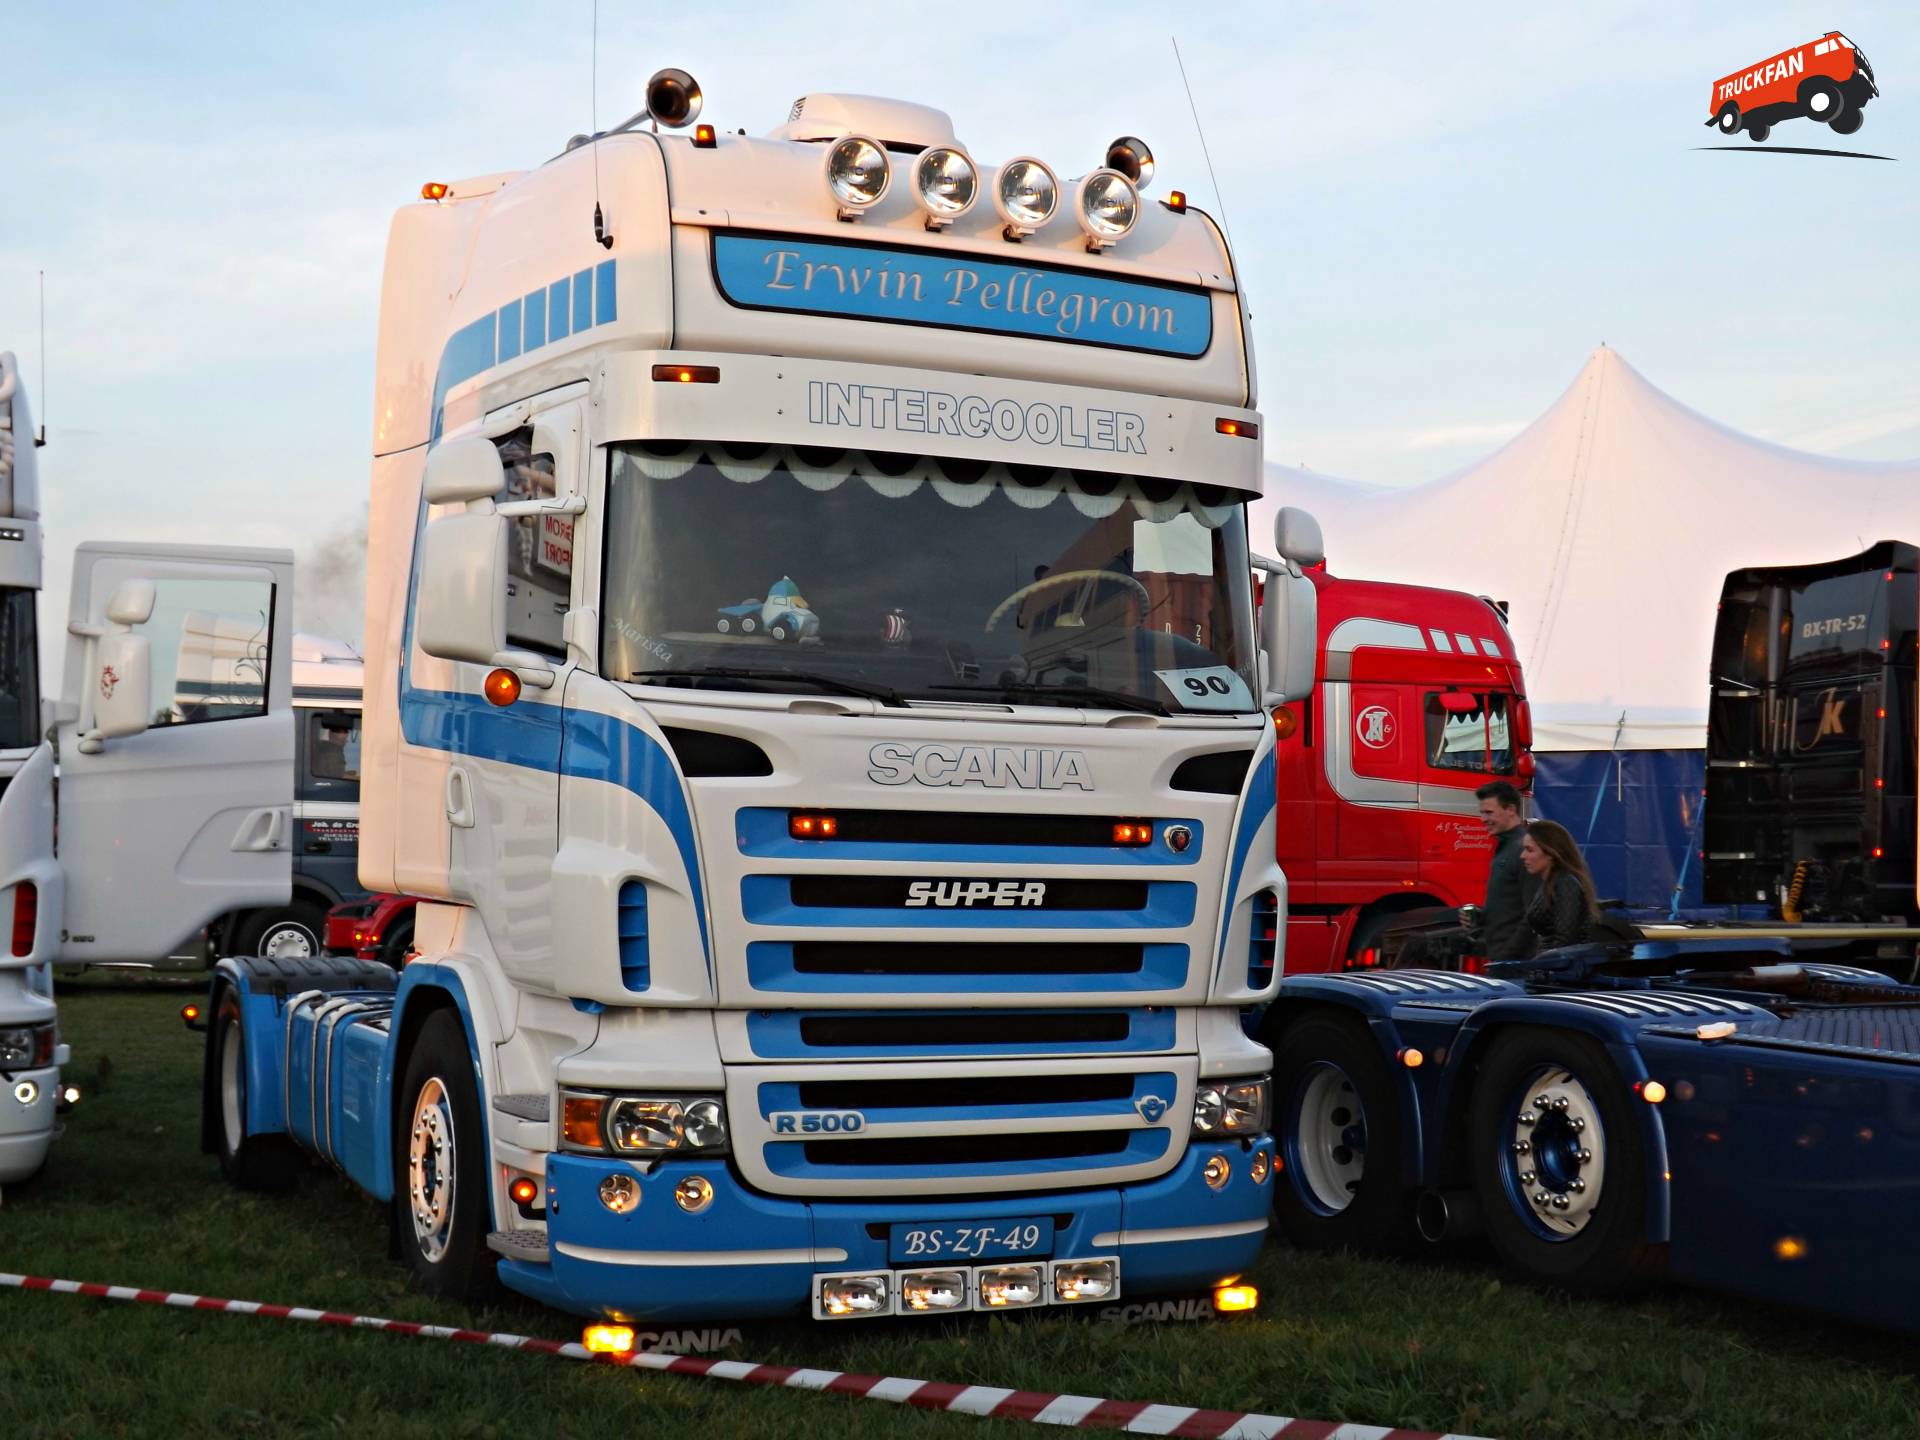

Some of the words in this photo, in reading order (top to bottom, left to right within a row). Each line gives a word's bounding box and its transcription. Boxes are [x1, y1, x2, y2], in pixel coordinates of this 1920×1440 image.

[764, 251, 927, 302] Erwin
[944, 269, 1178, 335] Pellegrom
[808, 381, 1147, 455] INTERCOOLER
[1803, 614, 1867, 638] BX-TR-52
[1183, 675, 1231, 697] 90
[867, 742, 1095, 791] SCANIA
[905, 881, 1046, 907] SUPER
[776, 1114, 797, 1133] R
[802, 1113, 862, 1133] 500
[904, 1224, 1040, 1257] BS-ZF-49
[1101, 1298, 1216, 1324] SCANIA
[634, 1328, 743, 1354] CANIA
